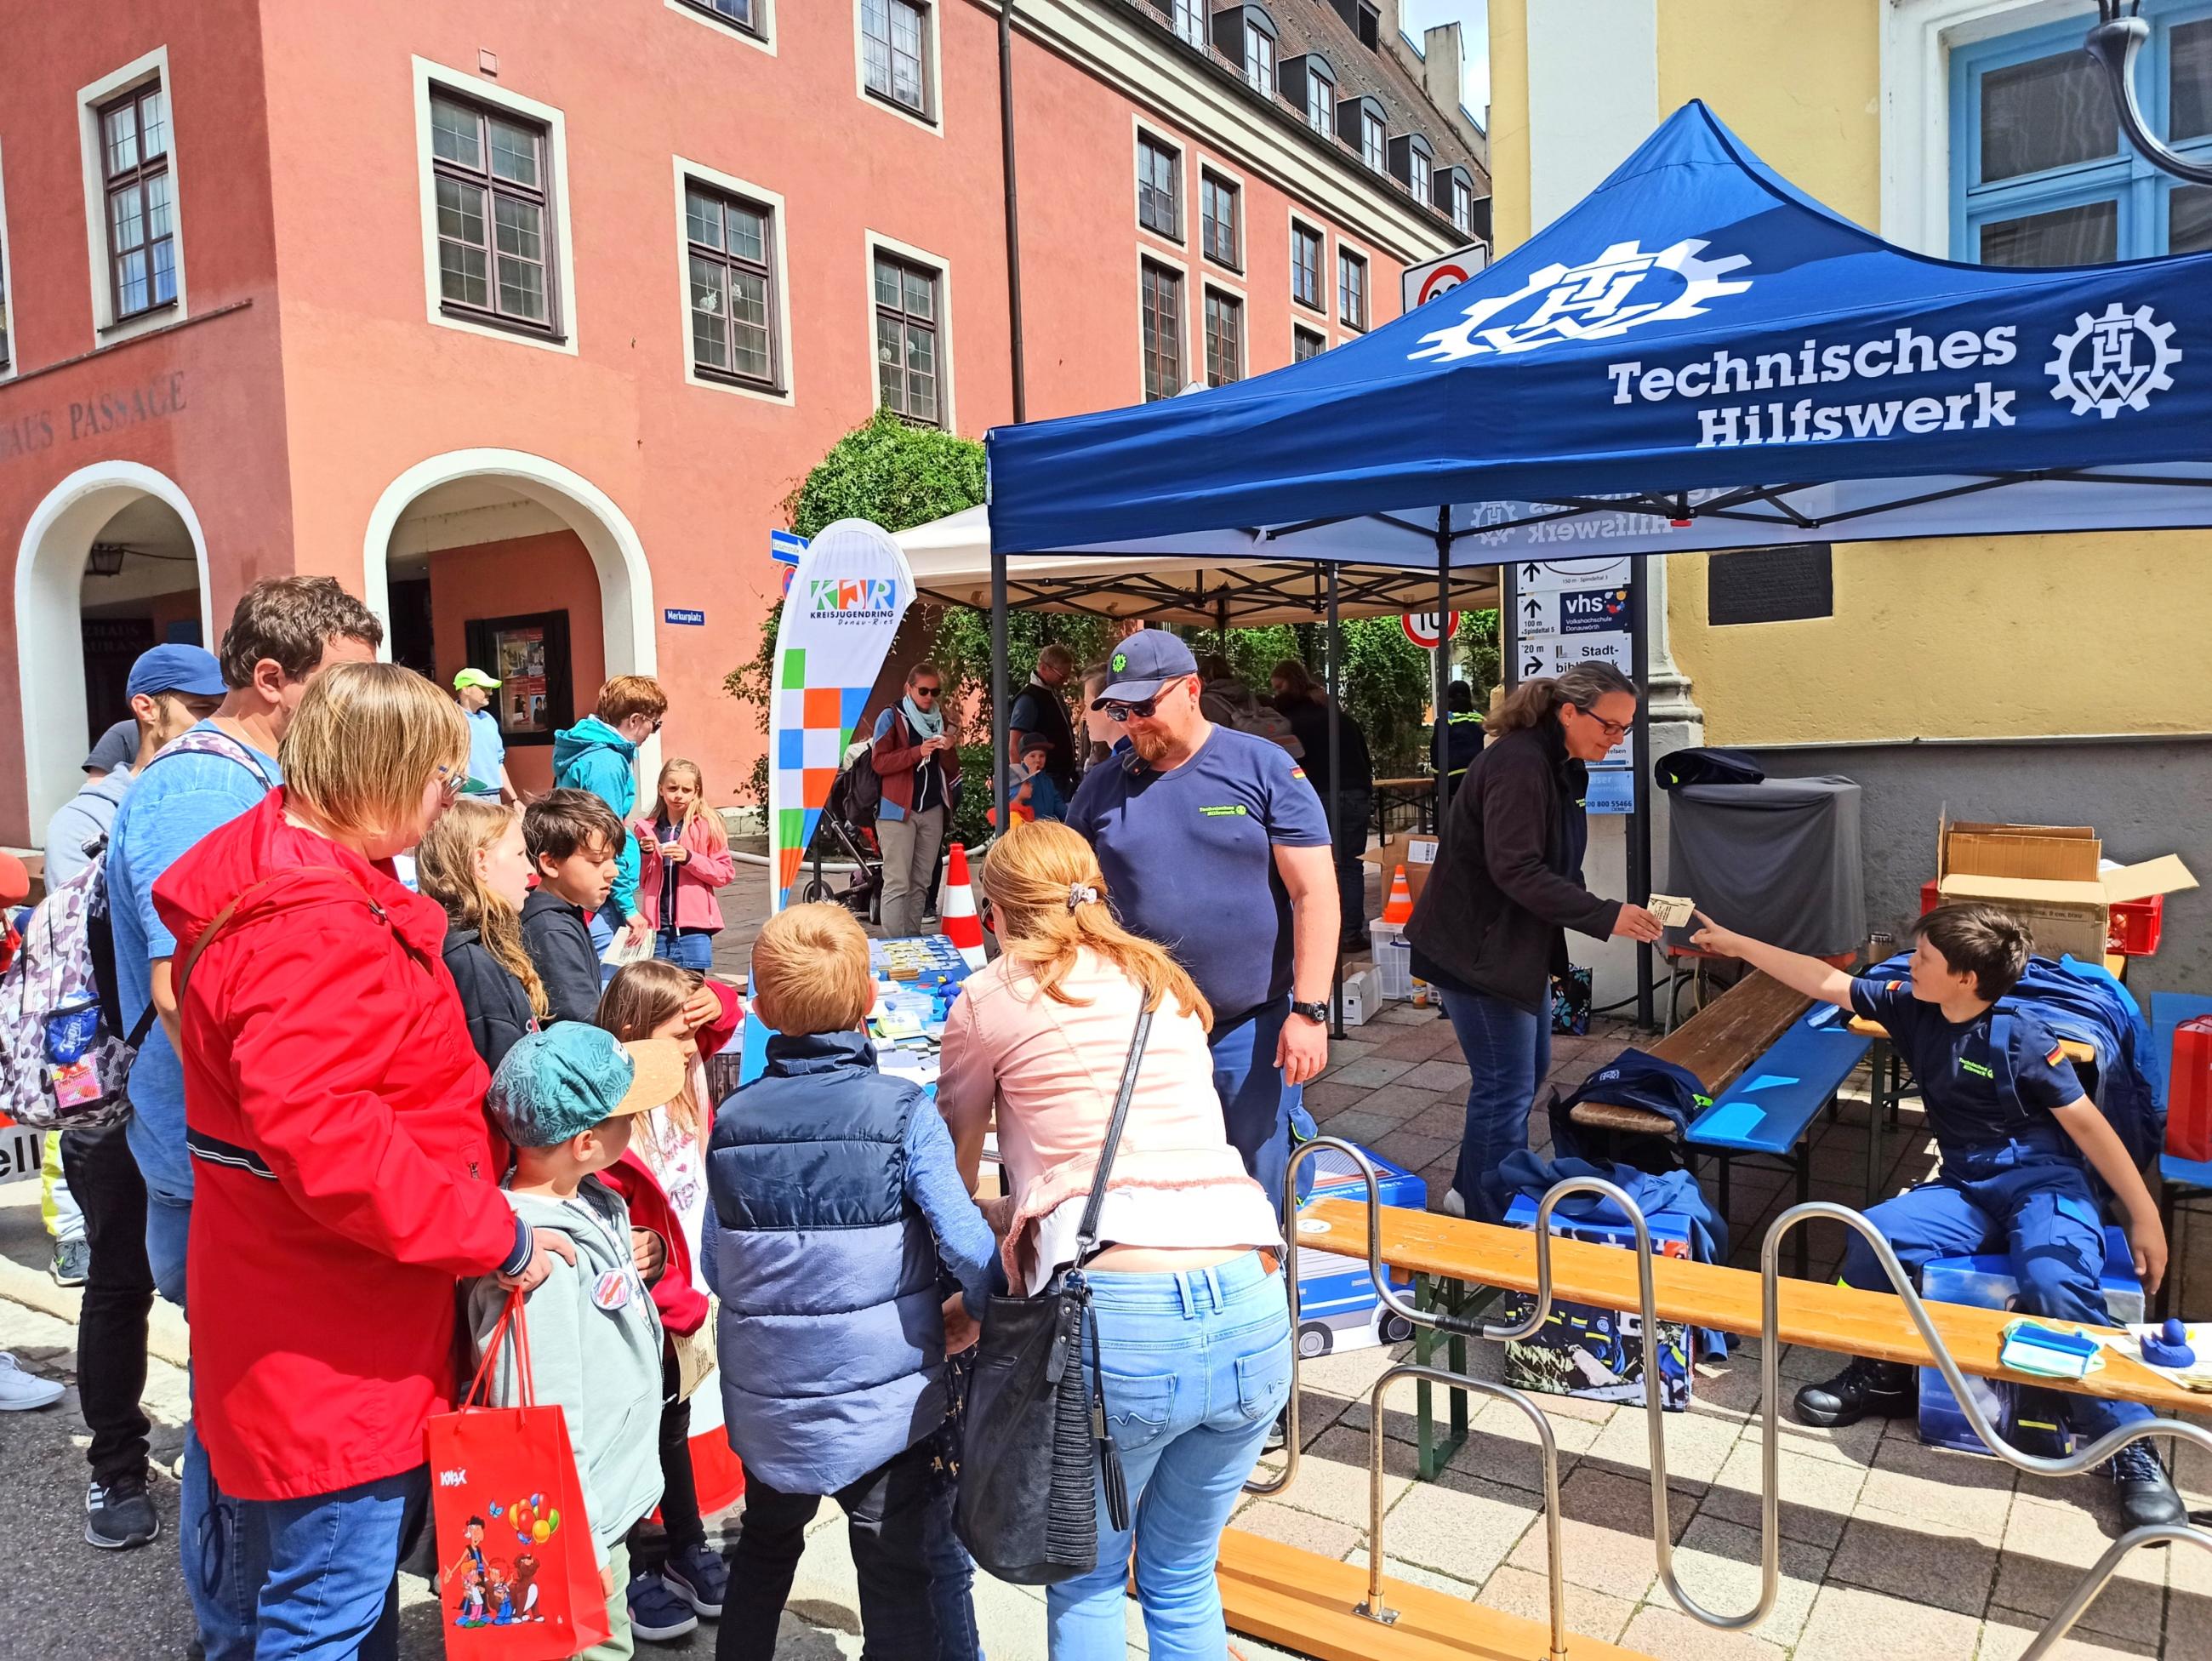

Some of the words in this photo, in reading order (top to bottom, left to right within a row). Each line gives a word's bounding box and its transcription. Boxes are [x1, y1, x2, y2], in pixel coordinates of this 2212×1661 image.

[1608, 325, 2017, 405] Technisches
[69, 371, 187, 441] PASSAGE
[1695, 382, 2016, 448] Hilfswerk
[1565, 594, 1604, 614] vhs
[667, 610, 702, 623] Merkurplatz
[810, 610, 894, 619] KREISJUGENDRING
[1565, 616, 1613, 625] Volkshochschule
[1565, 624, 1600, 632] Donauwörth
[1524, 645, 1534, 654] 20
[1582, 645, 1619, 657] Stadt-
